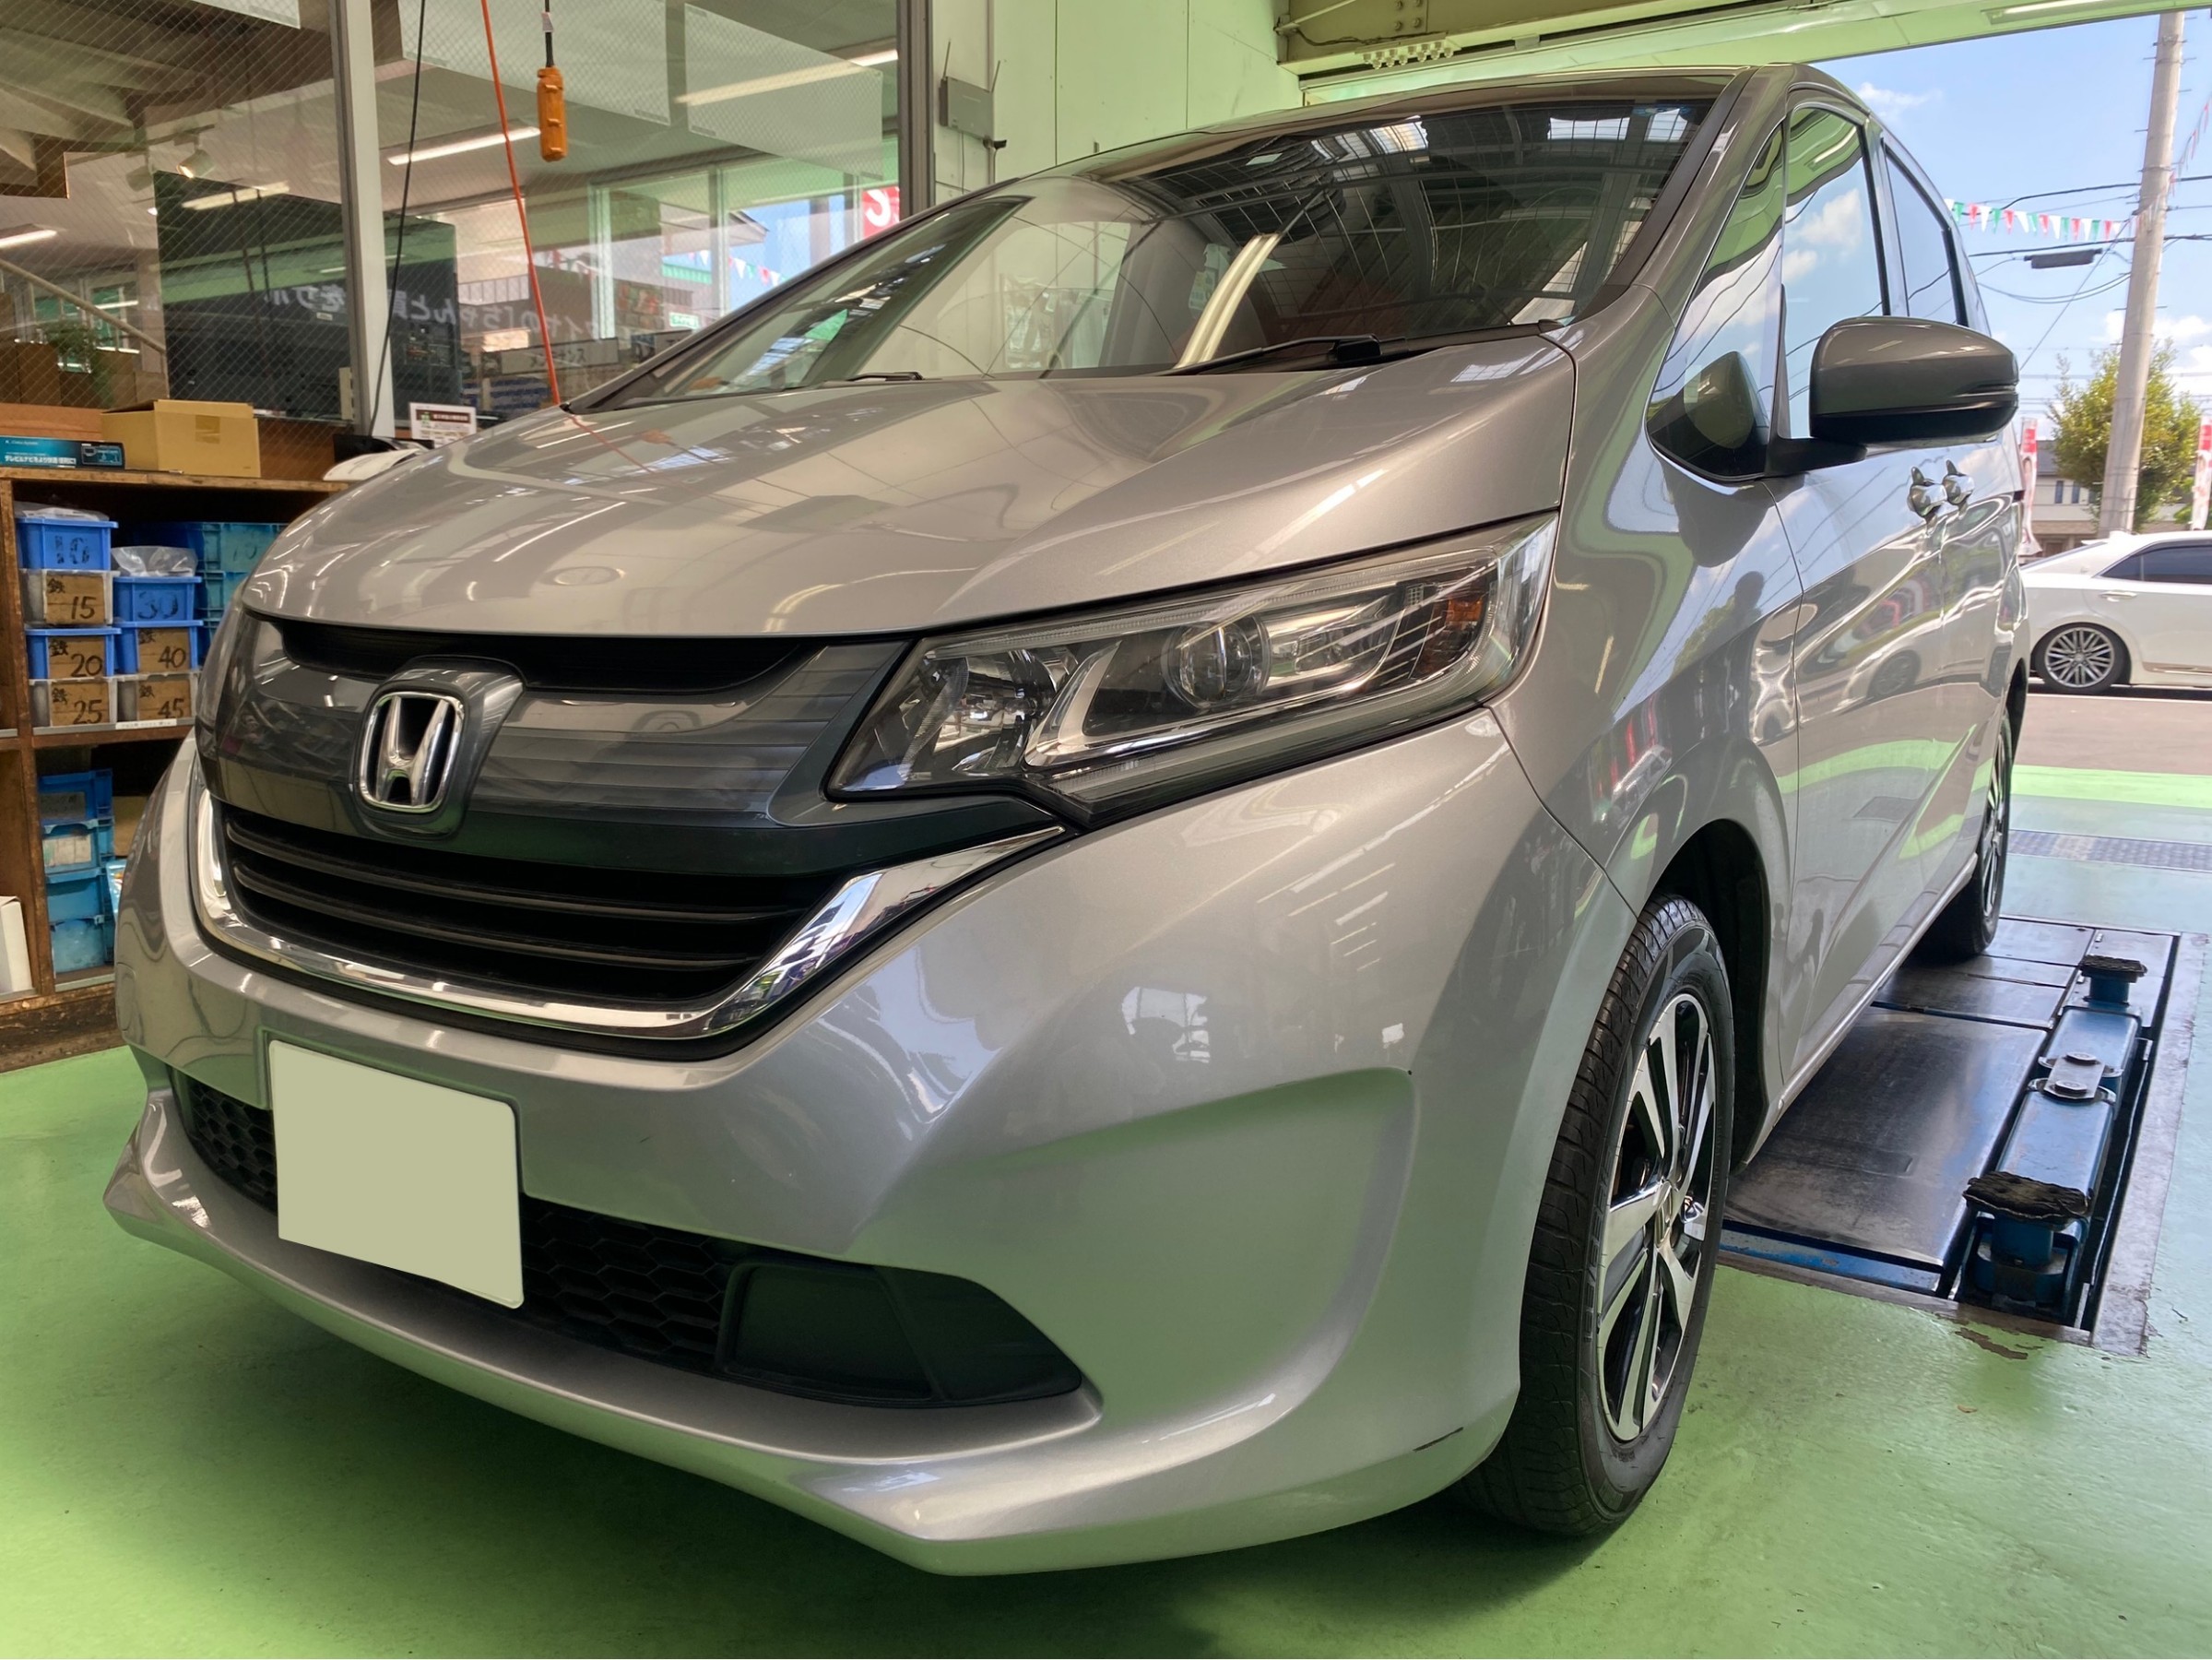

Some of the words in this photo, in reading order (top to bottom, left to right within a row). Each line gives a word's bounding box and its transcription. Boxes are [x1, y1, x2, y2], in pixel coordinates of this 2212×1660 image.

[70, 596, 97, 620] 15
[70, 653, 103, 677] 20
[158, 646, 186, 669] 40
[73, 699, 103, 724] 25
[158, 698, 184, 718] 45
